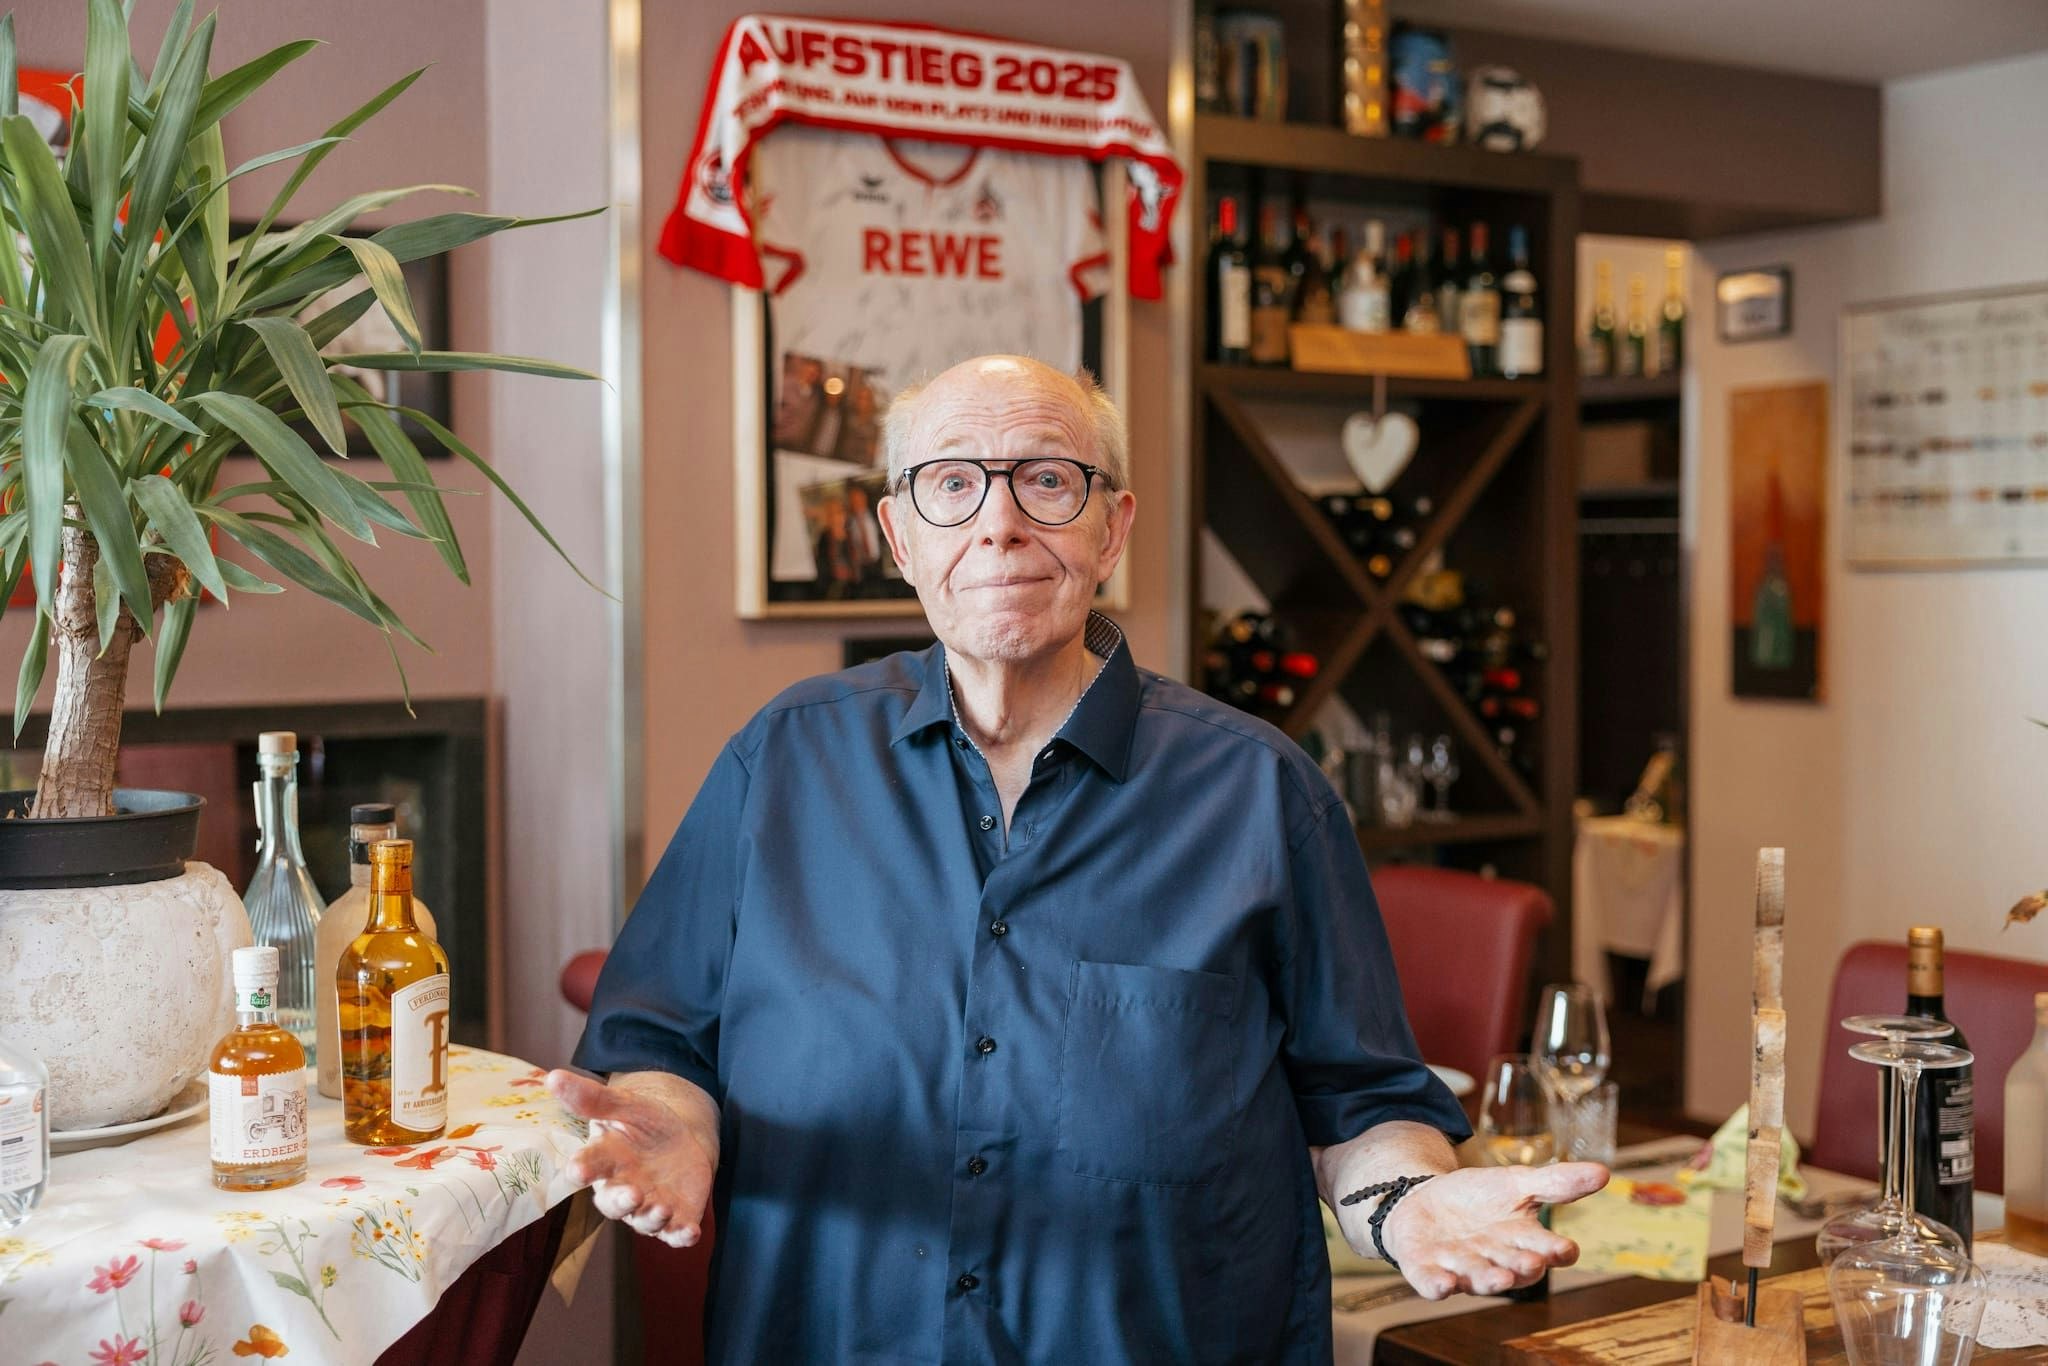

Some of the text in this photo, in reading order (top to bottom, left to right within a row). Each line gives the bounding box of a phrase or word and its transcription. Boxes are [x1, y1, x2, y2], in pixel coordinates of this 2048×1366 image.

[738, 25, 1120, 102] AUFSTIEG 2025
[863, 228, 1002, 280] REWE
[243, 1142, 300, 1158] ERDBEER
